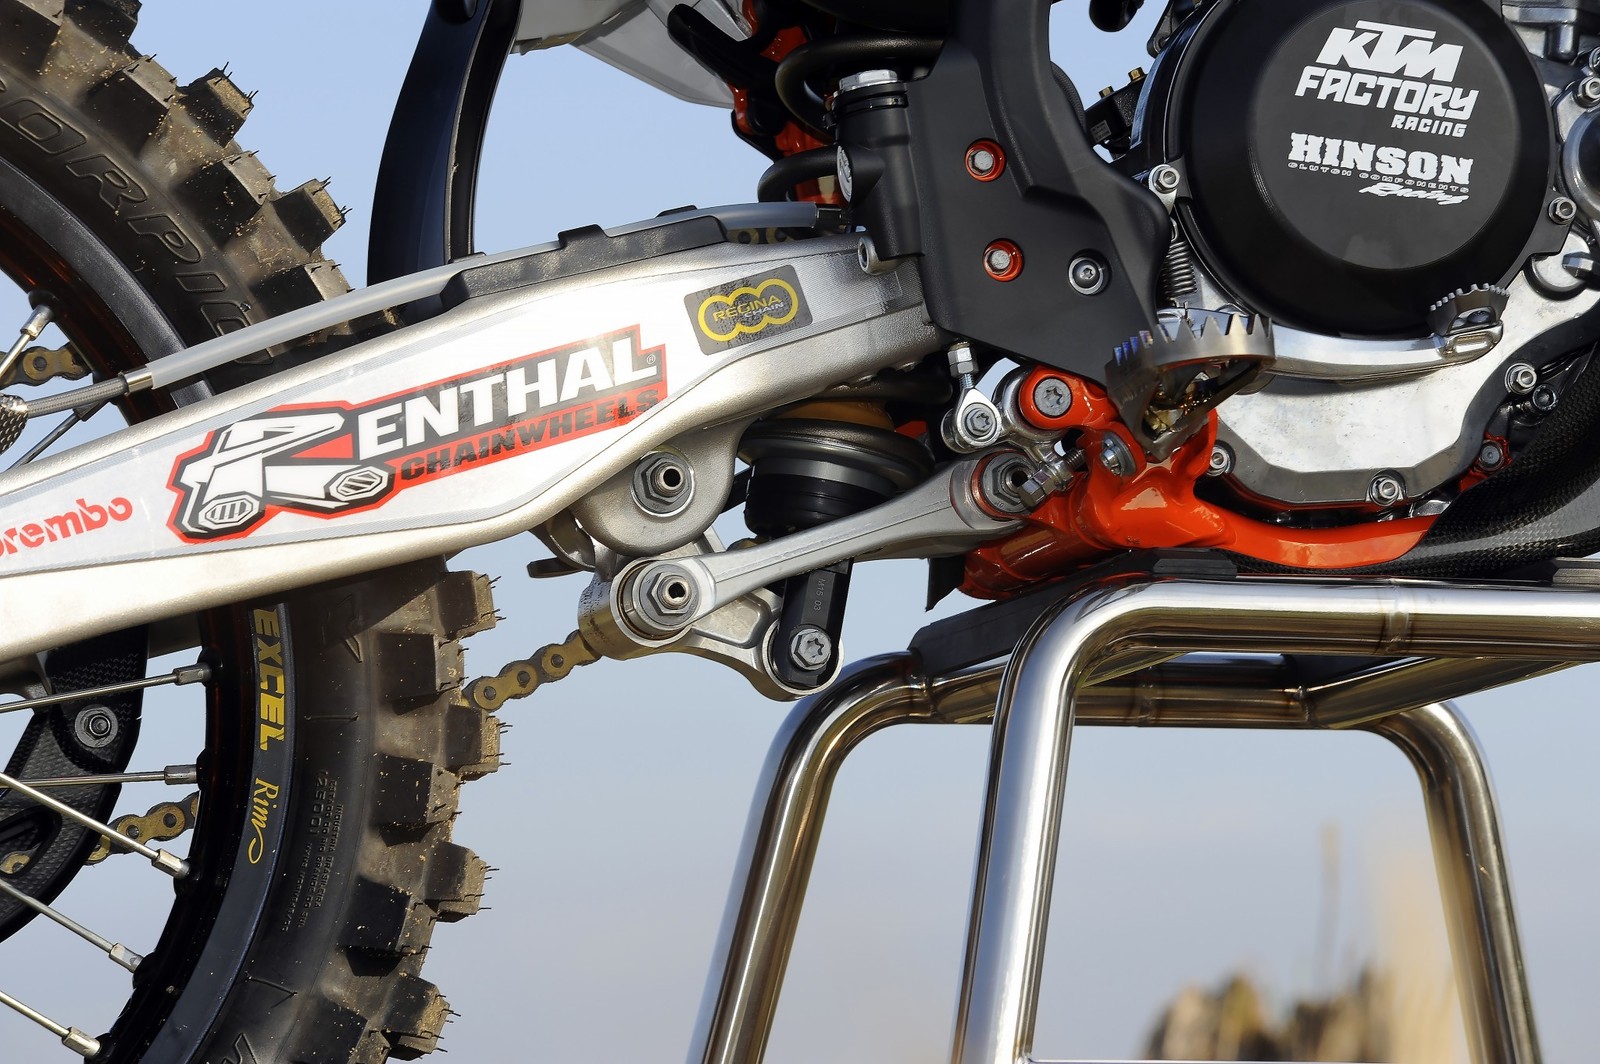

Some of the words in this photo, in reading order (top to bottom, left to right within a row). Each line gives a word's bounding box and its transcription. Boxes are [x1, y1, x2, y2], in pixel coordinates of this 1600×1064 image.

[1315, 20, 1464, 83] KTM
[1294, 65, 1480, 121] FACTORY
[1390, 114, 1468, 138] RACING
[1287, 132, 1474, 185] HINSON
[1287, 161, 1352, 177] CLUTCH
[1358, 172, 1470, 194] COMPONENTS
[712, 294, 782, 322] REGINA
[743, 301, 785, 319] CHAIN
[180, 336, 658, 533] RENTHAL
[400, 388, 661, 482] CHAINWHEELS
[0, 496, 133, 557] rembo
[253, 607, 287, 752] EXCEL
[248, 776, 280, 865] Rim
[307, 856, 324, 893] GRANDE
